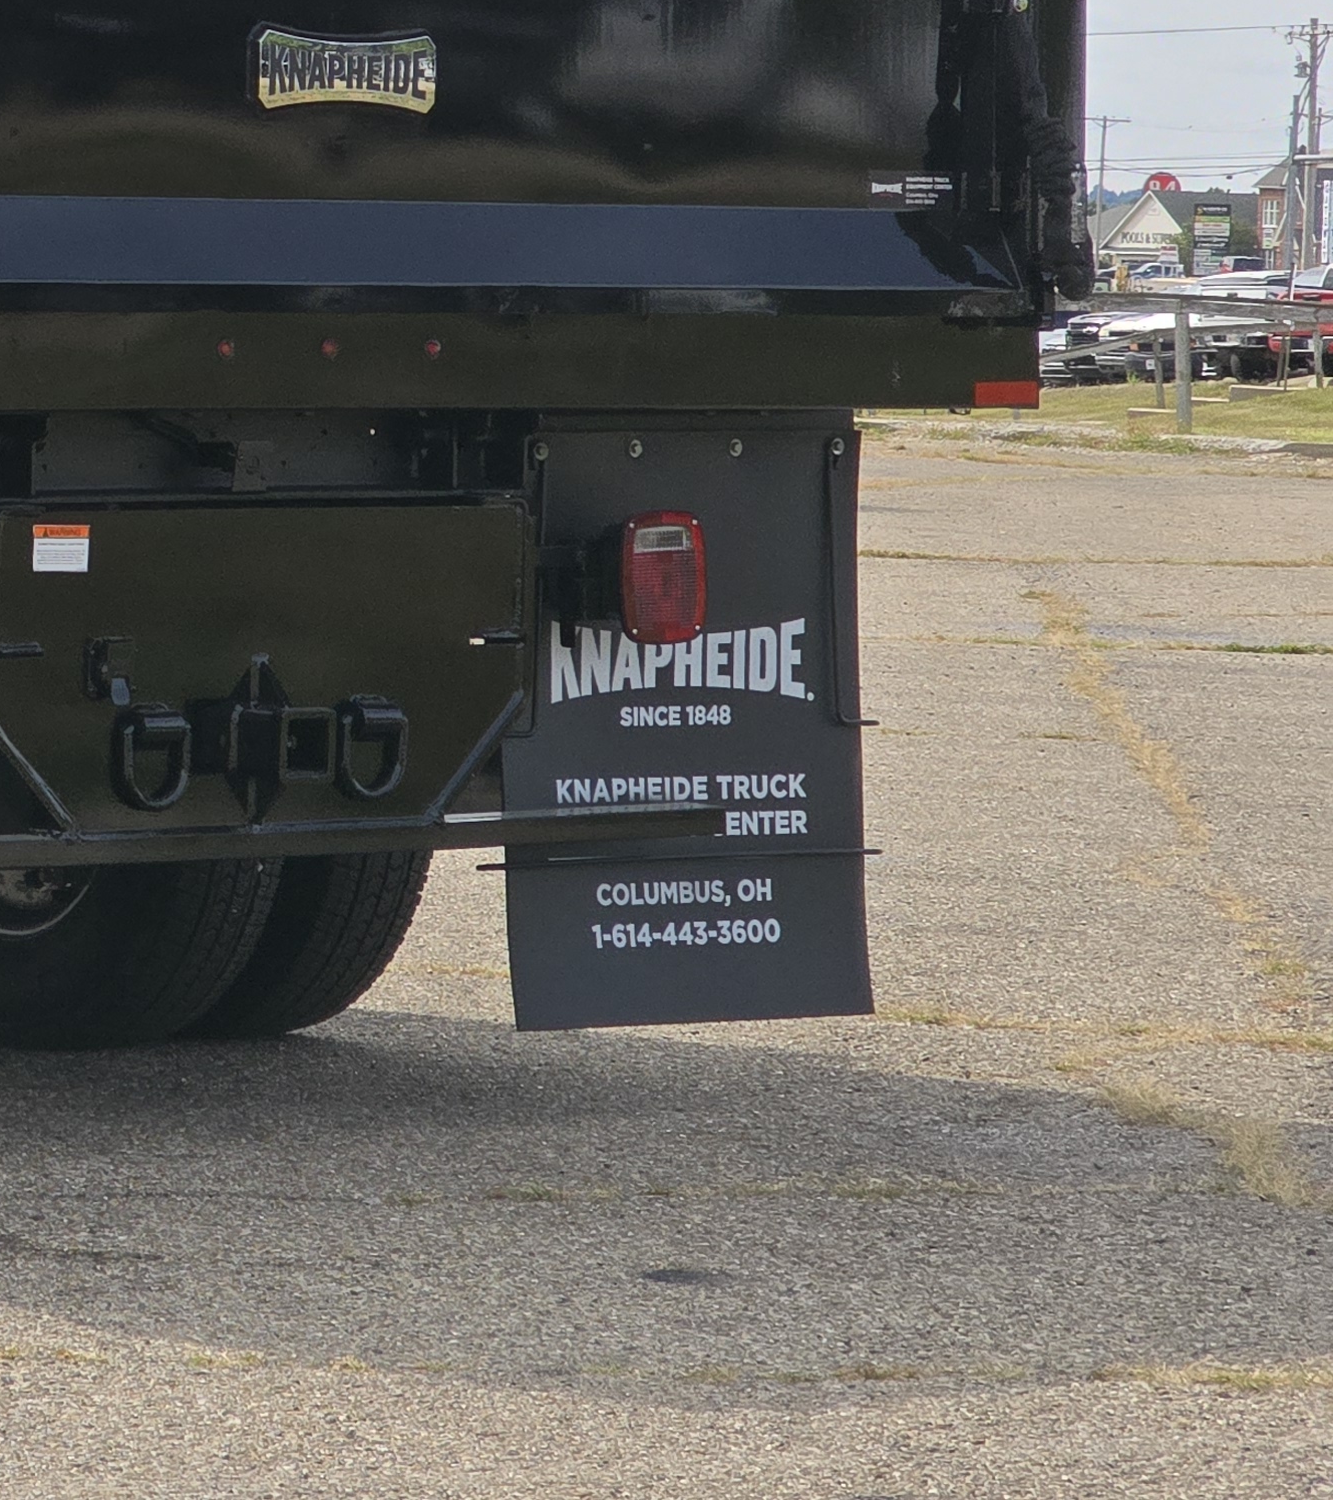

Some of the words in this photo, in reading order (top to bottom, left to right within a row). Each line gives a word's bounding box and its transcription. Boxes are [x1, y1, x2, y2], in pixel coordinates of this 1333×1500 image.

[268, 47, 427, 100] KNAPHEIDE
[620, 705, 681, 727] SINCE
[685, 704, 732, 726] 1848
[556, 775, 708, 803] KNAPHEIDE
[716, 773, 807, 800] TRUCK
[714, 810, 808, 836] ENTER
[596, 879, 731, 907] COLUMBUS,
[737, 878, 773, 902] OH
[591, 918, 781, 949] 1-614-443-3600
